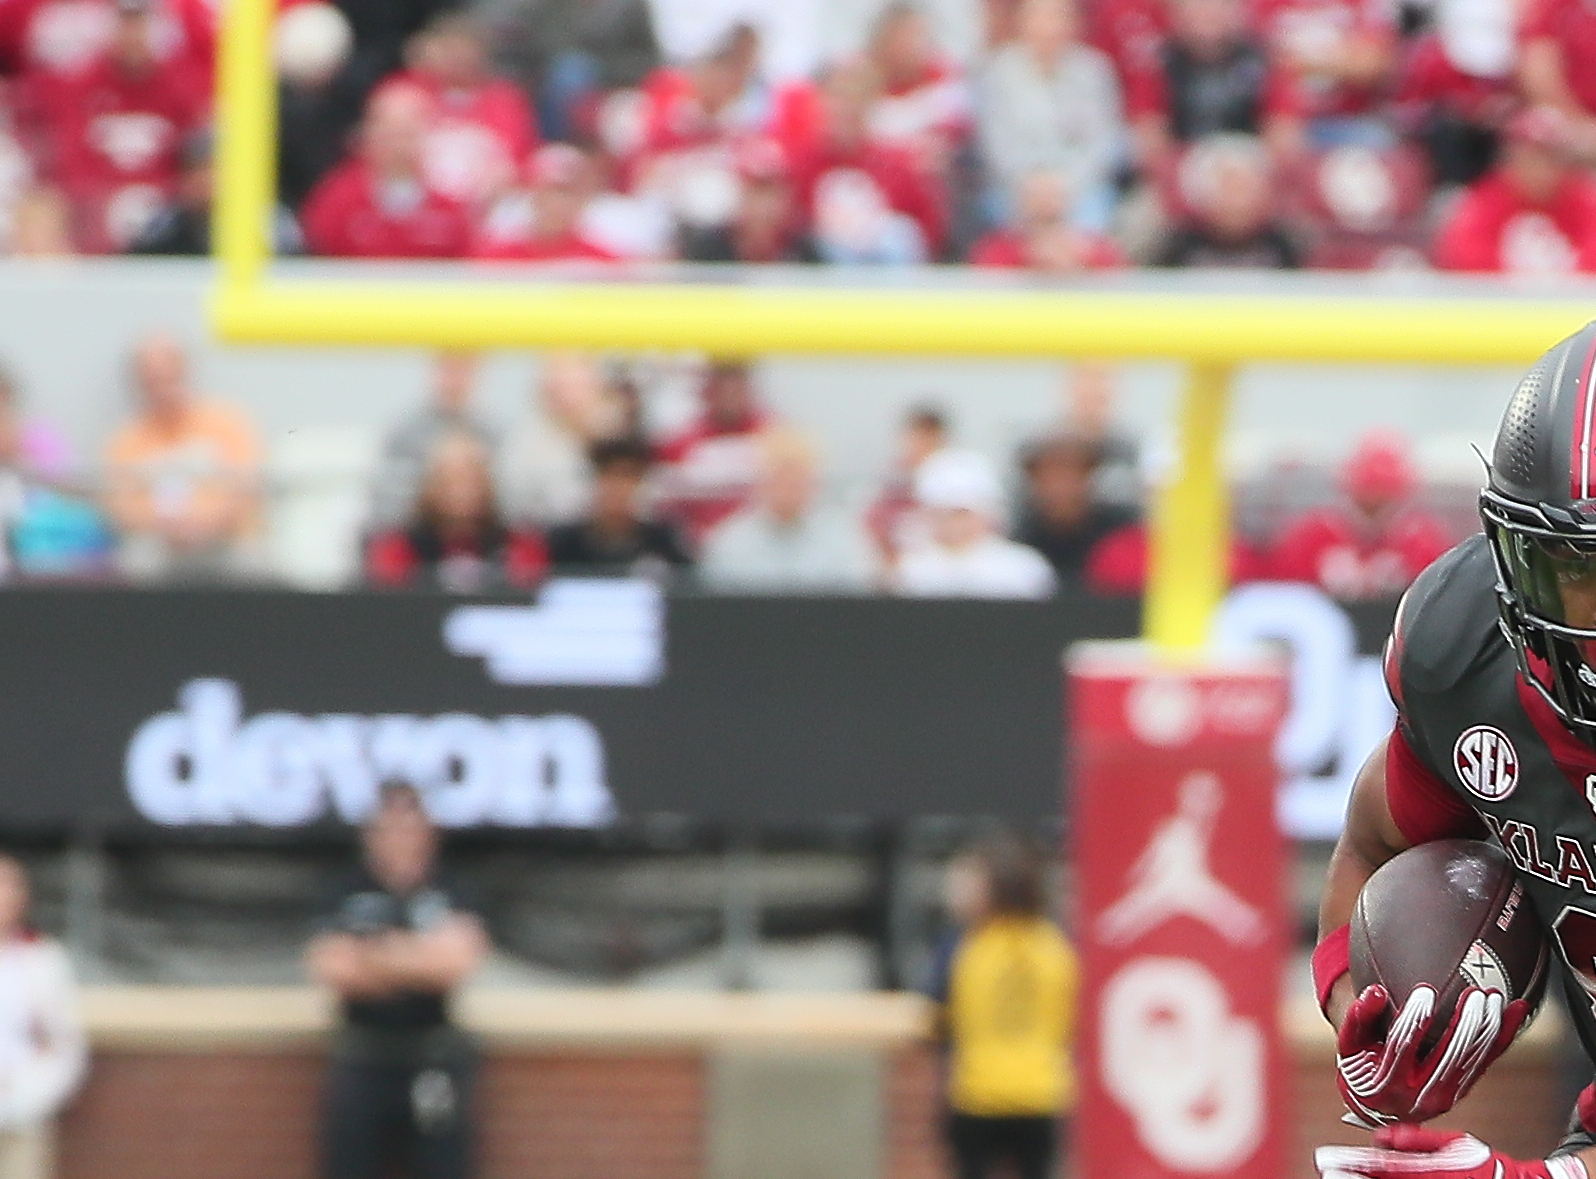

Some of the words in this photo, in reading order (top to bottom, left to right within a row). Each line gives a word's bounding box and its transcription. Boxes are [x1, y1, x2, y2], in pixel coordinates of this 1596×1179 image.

[126, 677, 615, 827] devon
[1458, 729, 1515, 798] SEC
[1100, 955, 1267, 1172] OU
